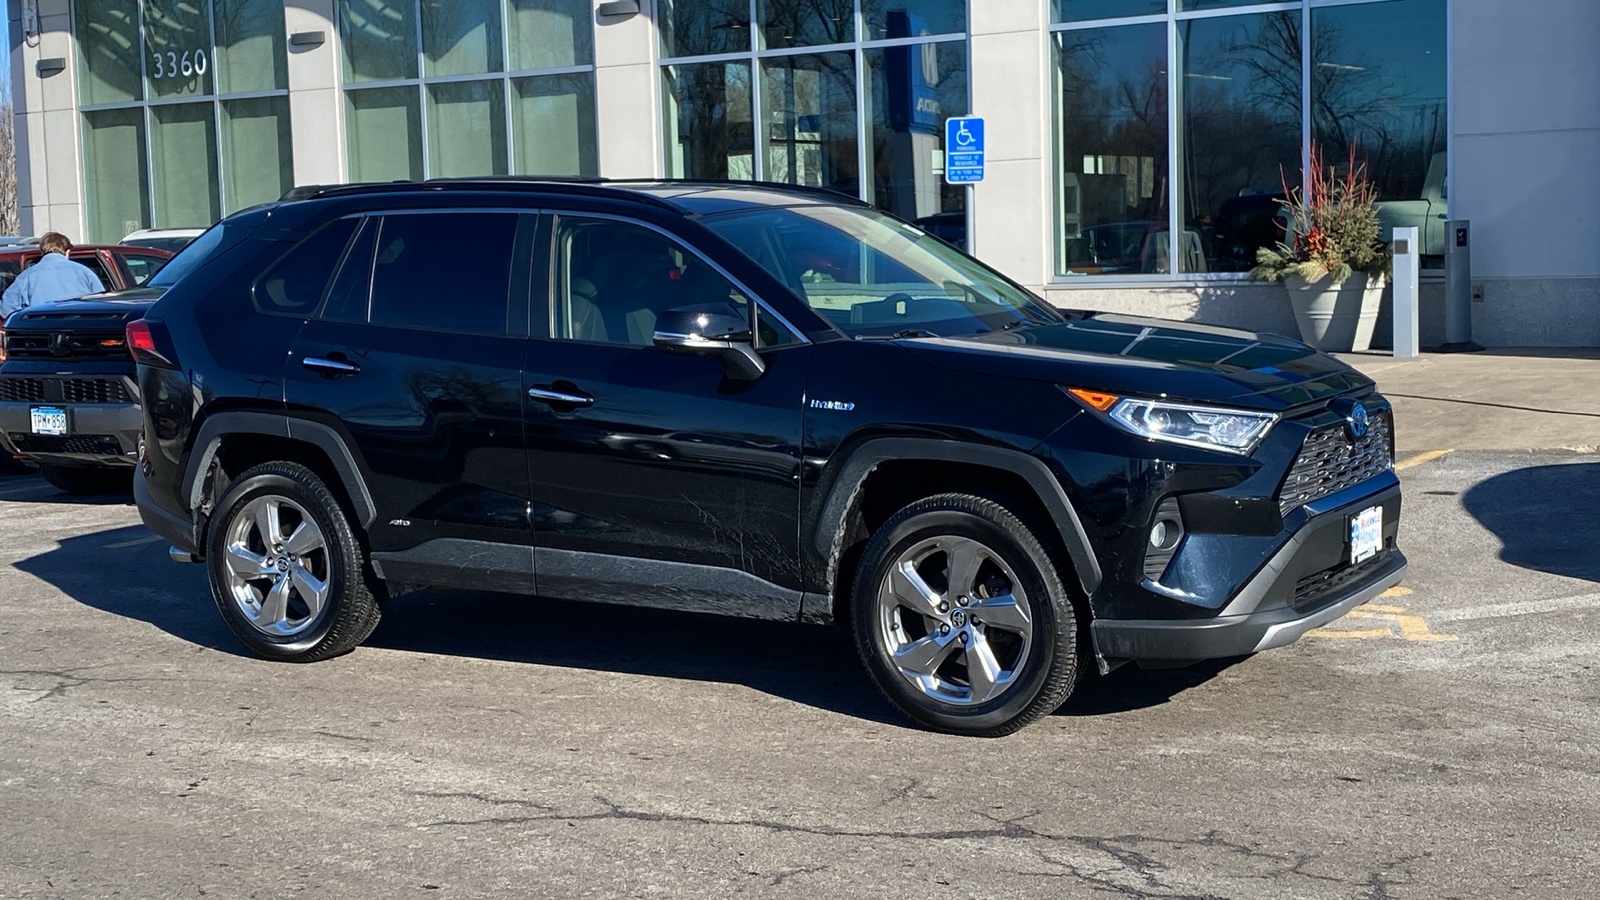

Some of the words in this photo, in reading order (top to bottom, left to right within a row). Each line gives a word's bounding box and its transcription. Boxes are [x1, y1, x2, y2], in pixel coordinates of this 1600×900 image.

[153, 48, 207, 78] 3360
[52, 414, 66, 429] 858
[1360, 527, 1381, 546] HONDA
